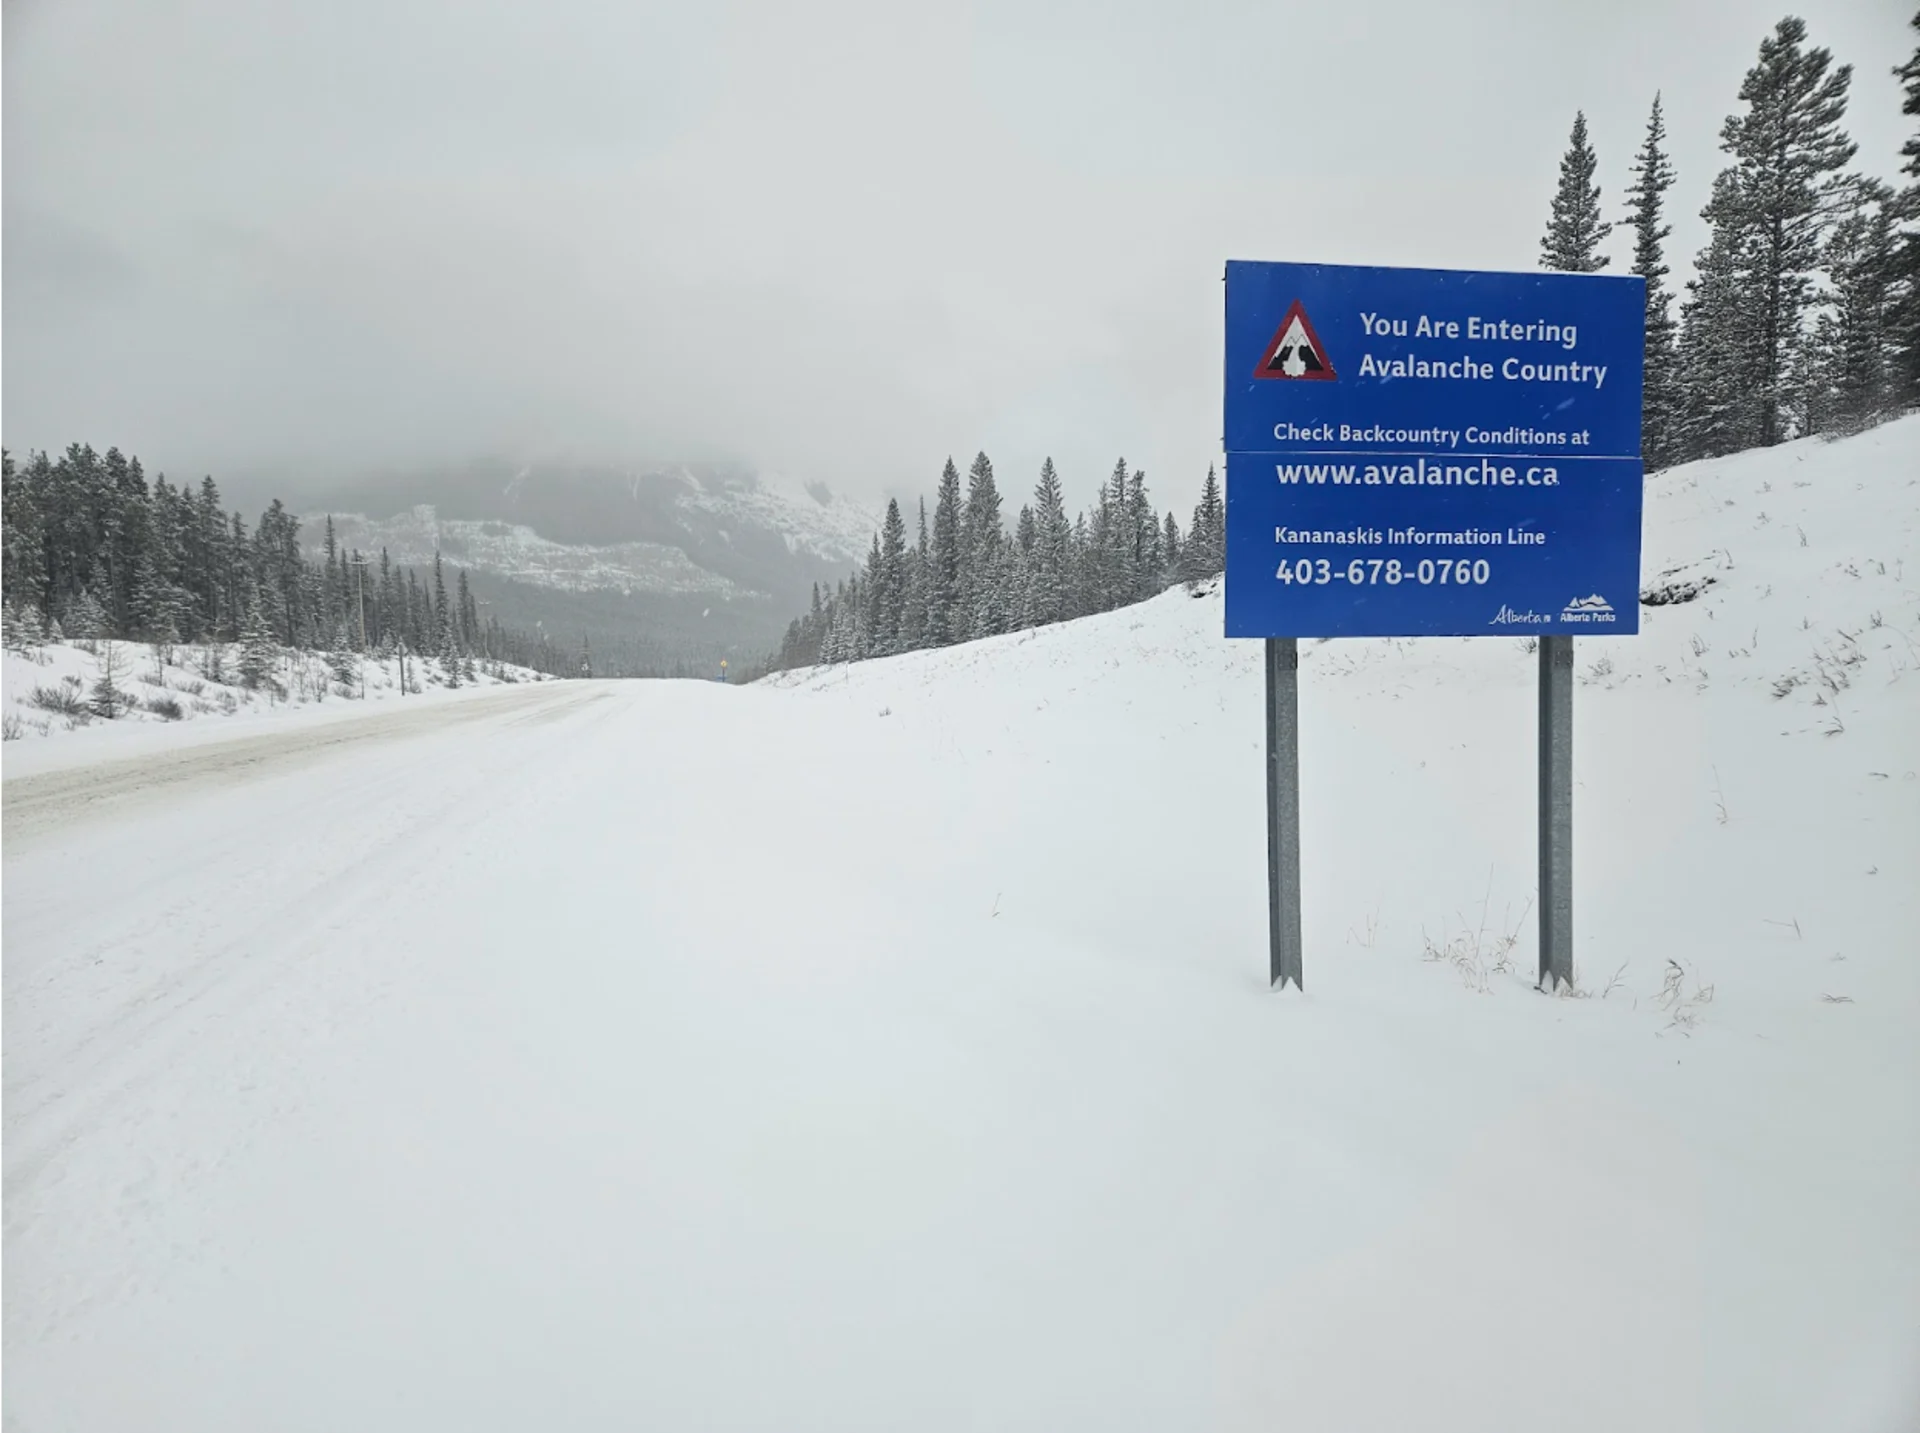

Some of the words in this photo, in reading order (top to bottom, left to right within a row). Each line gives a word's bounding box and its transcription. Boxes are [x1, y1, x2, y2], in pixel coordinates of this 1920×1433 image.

[1360, 312, 1407, 337] You
[1415, 315, 1459, 339] Are
[1468, 316, 1577, 350] Entering
[1359, 353, 1494, 380] Avalanche
[1502, 357, 1607, 389] Country
[1274, 423, 1335, 441] Check
[1340, 424, 1460, 448] Backcountry
[1465, 426, 1567, 445] Conditions
[1571, 430, 1590, 445] at
[1276, 458, 1559, 486] www.avalanche.ca
[1275, 526, 1383, 545] Kananaskis
[1388, 526, 1502, 545] Information
[1508, 528, 1546, 545] Line
[1275, 558, 1491, 585] 403-678-0760
[1489, 603, 1542, 625] Alberta
[1560, 612, 1591, 622] Alberta
[1592, 612, 1616, 622] Parks
